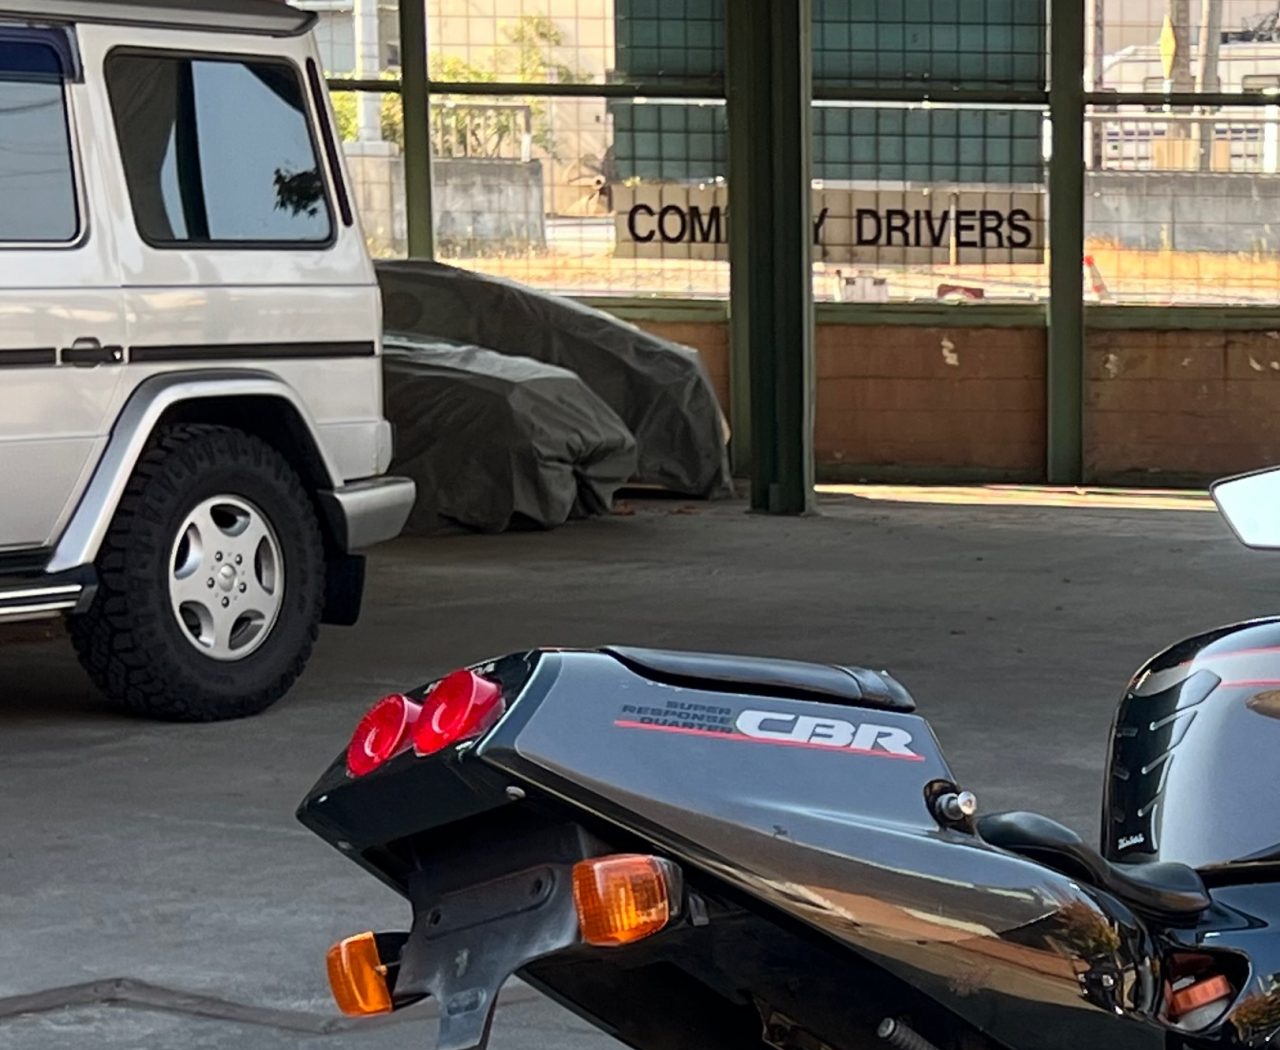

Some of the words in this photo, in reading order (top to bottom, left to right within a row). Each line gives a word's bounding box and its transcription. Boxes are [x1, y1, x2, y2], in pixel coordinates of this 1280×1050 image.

[855, 207, 1033, 249] DRIVERS
[622, 704, 732, 724] RESPONSE
[666, 700, 732, 715] SUPER
[640, 717, 733, 733] QUARTER
[736, 709, 918, 757] CBR
